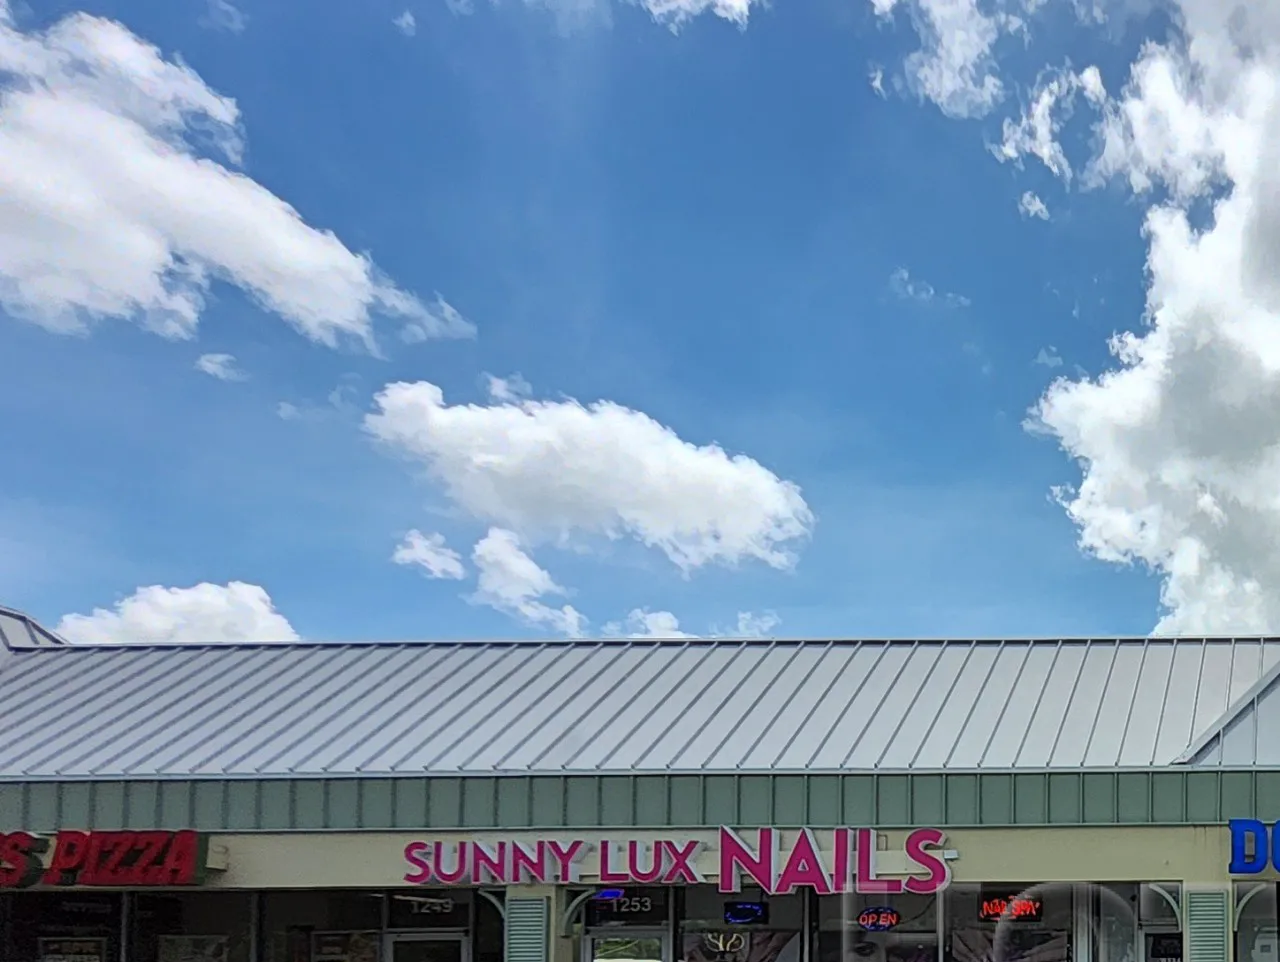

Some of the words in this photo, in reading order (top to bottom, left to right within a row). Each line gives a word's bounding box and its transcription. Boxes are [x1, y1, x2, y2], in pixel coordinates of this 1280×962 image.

[42, 830, 199, 886] PIZZA
[403, 840, 584, 884] SUNNY
[599, 840, 698, 882] LUX
[718, 825, 947, 894] NAILS
[611, 897, 652, 913] 1253
[858, 912, 898, 926] OPEN
